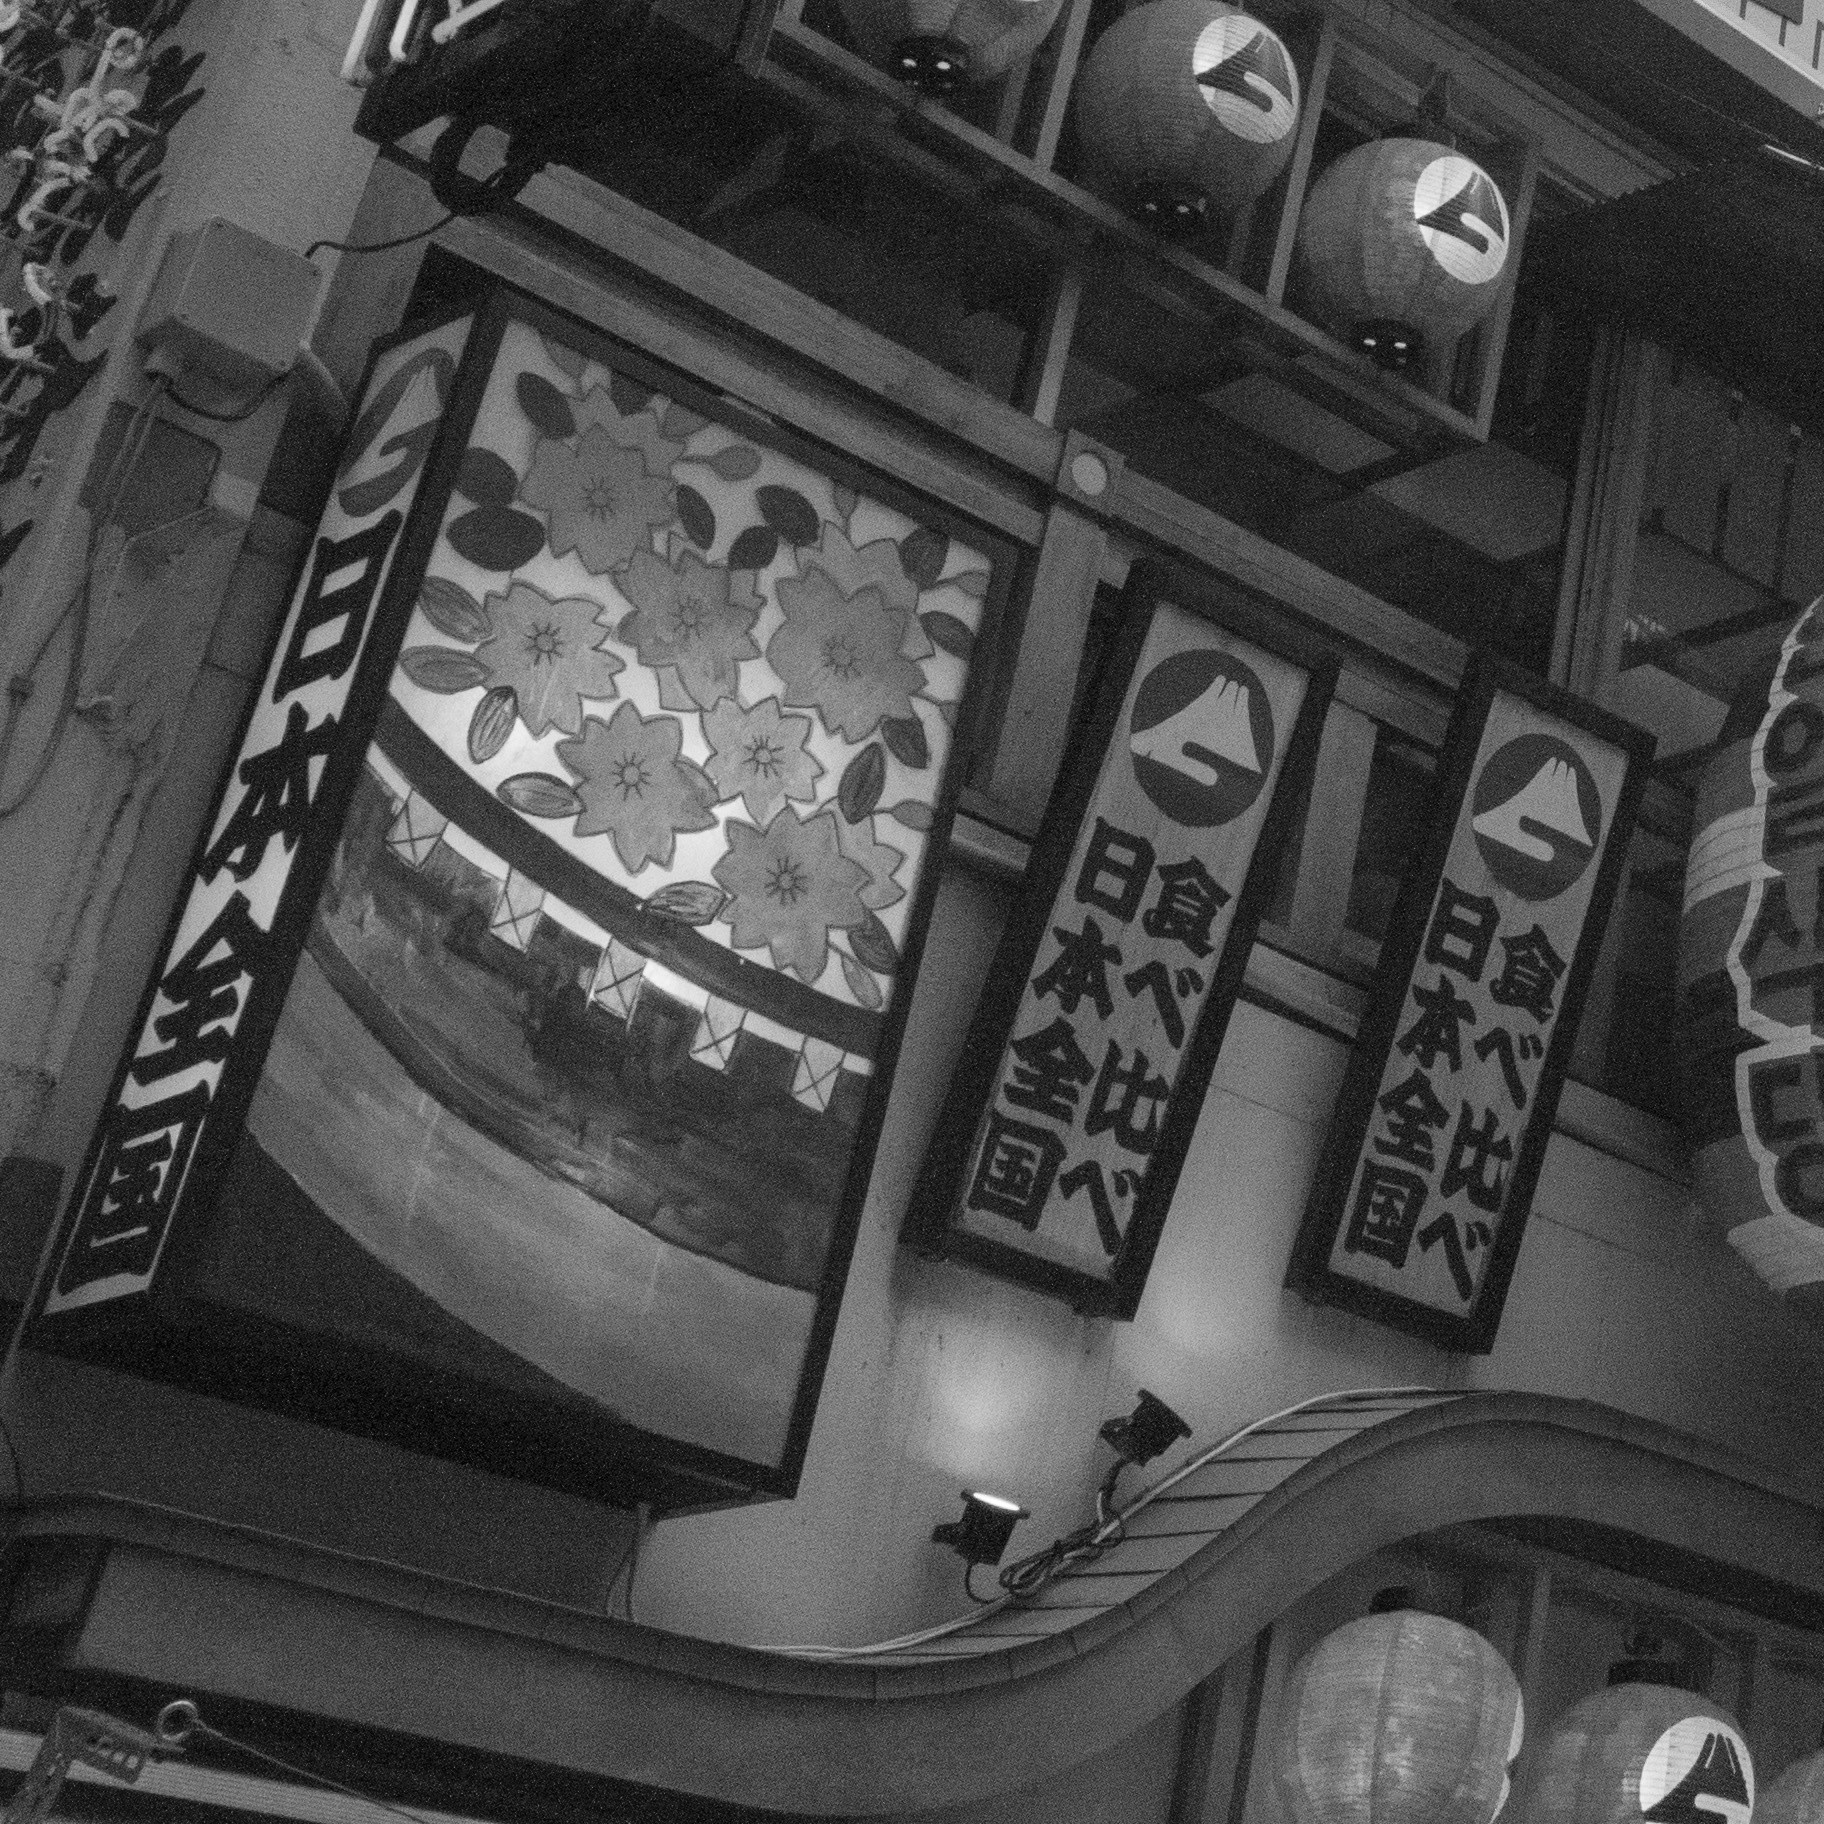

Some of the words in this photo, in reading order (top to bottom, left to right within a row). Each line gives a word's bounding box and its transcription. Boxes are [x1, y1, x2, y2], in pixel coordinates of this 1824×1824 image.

[57, 509, 403, 1295] 日本全国
[965, 812, 1156, 1232] 日本全国
[1058, 852, 1234, 1257] 食べ比べ
[1344, 877, 1501, 1269] 日本全国
[1417, 920, 1568, 1303] 食べ比べ
